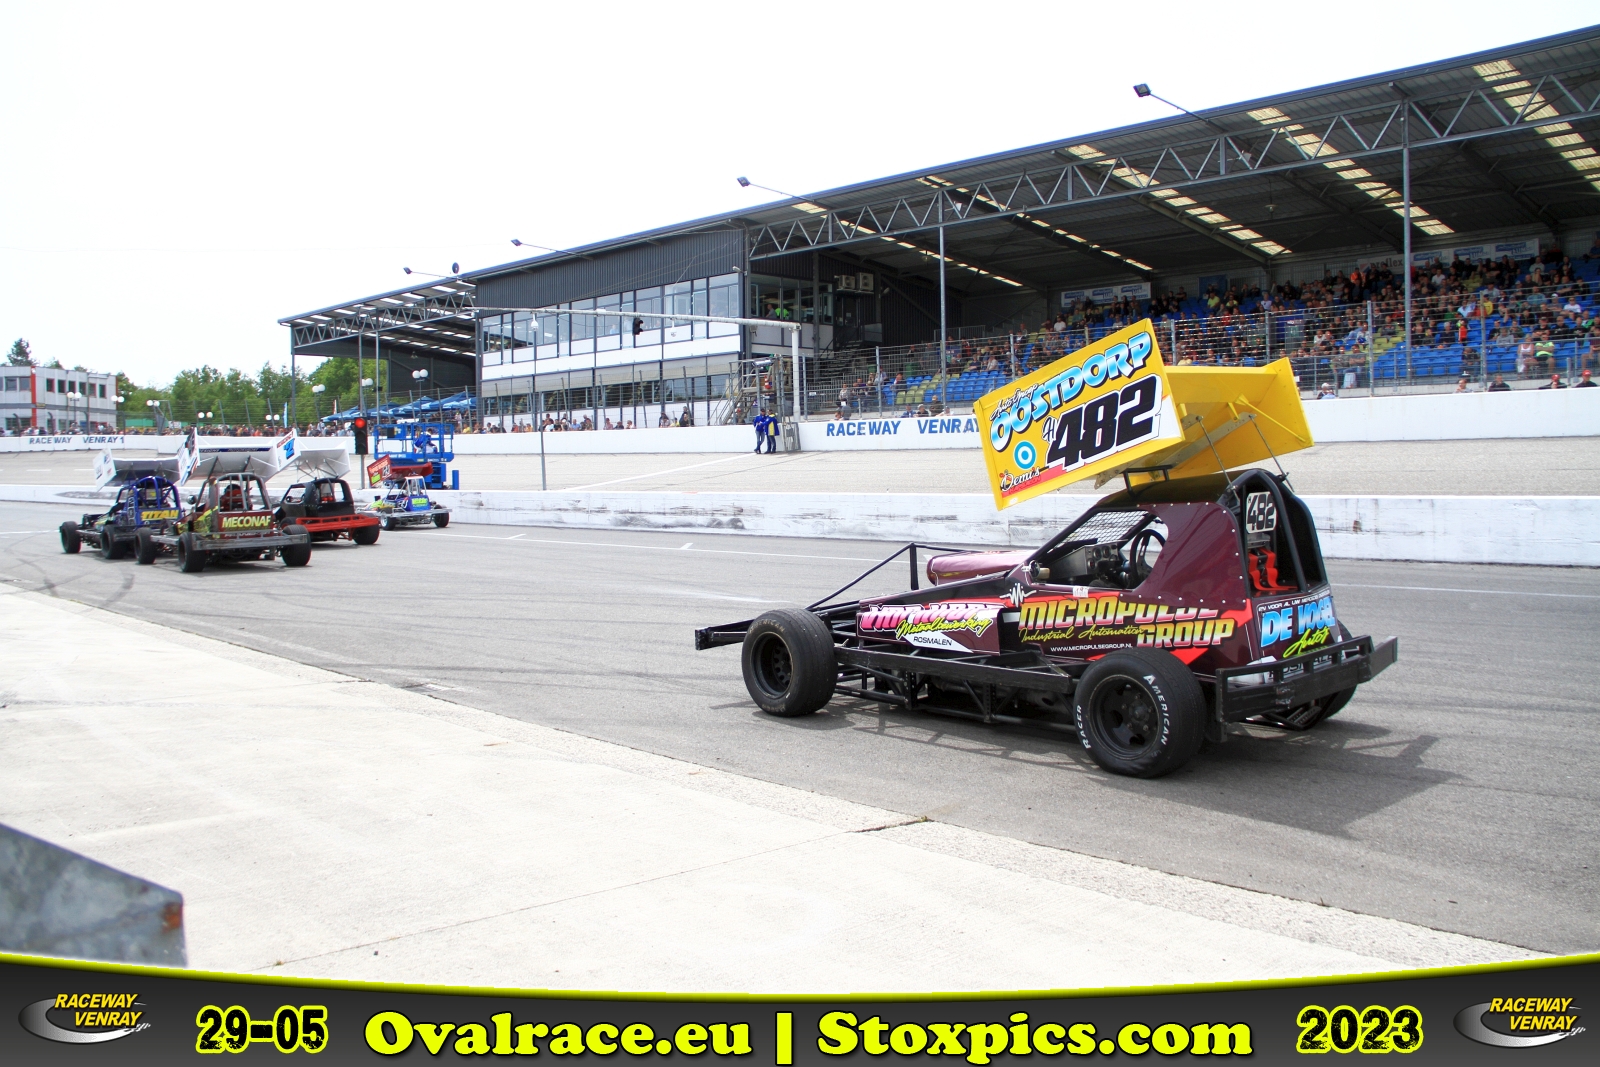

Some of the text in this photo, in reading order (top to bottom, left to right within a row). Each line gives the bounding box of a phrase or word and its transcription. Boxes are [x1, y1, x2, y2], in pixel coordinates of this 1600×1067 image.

[990, 332, 1153, 452] OOSTDORP
[826, 420, 901, 437] RACEWAY
[1046, 374, 1158, 468] 482
[83, 436, 118, 444] VENRAY
[141, 510, 179, 521] TITAN
[222, 516, 272, 528] MECONAF
[1247, 494, 1275, 531] 482
[1019, 623, 1145, 643] Industrial Automation
[1136, 618, 1236, 649] GROUP
[1261, 596, 1335, 648] DE VOGEL
[913, 636, 953, 646] ROSMALEN
[1050, 643, 1133, 652] WWW.MICROPULSEGROUP.NL
[1143, 674, 1170, 746] AMERICAN
[1076, 705, 1092, 749] RACER
